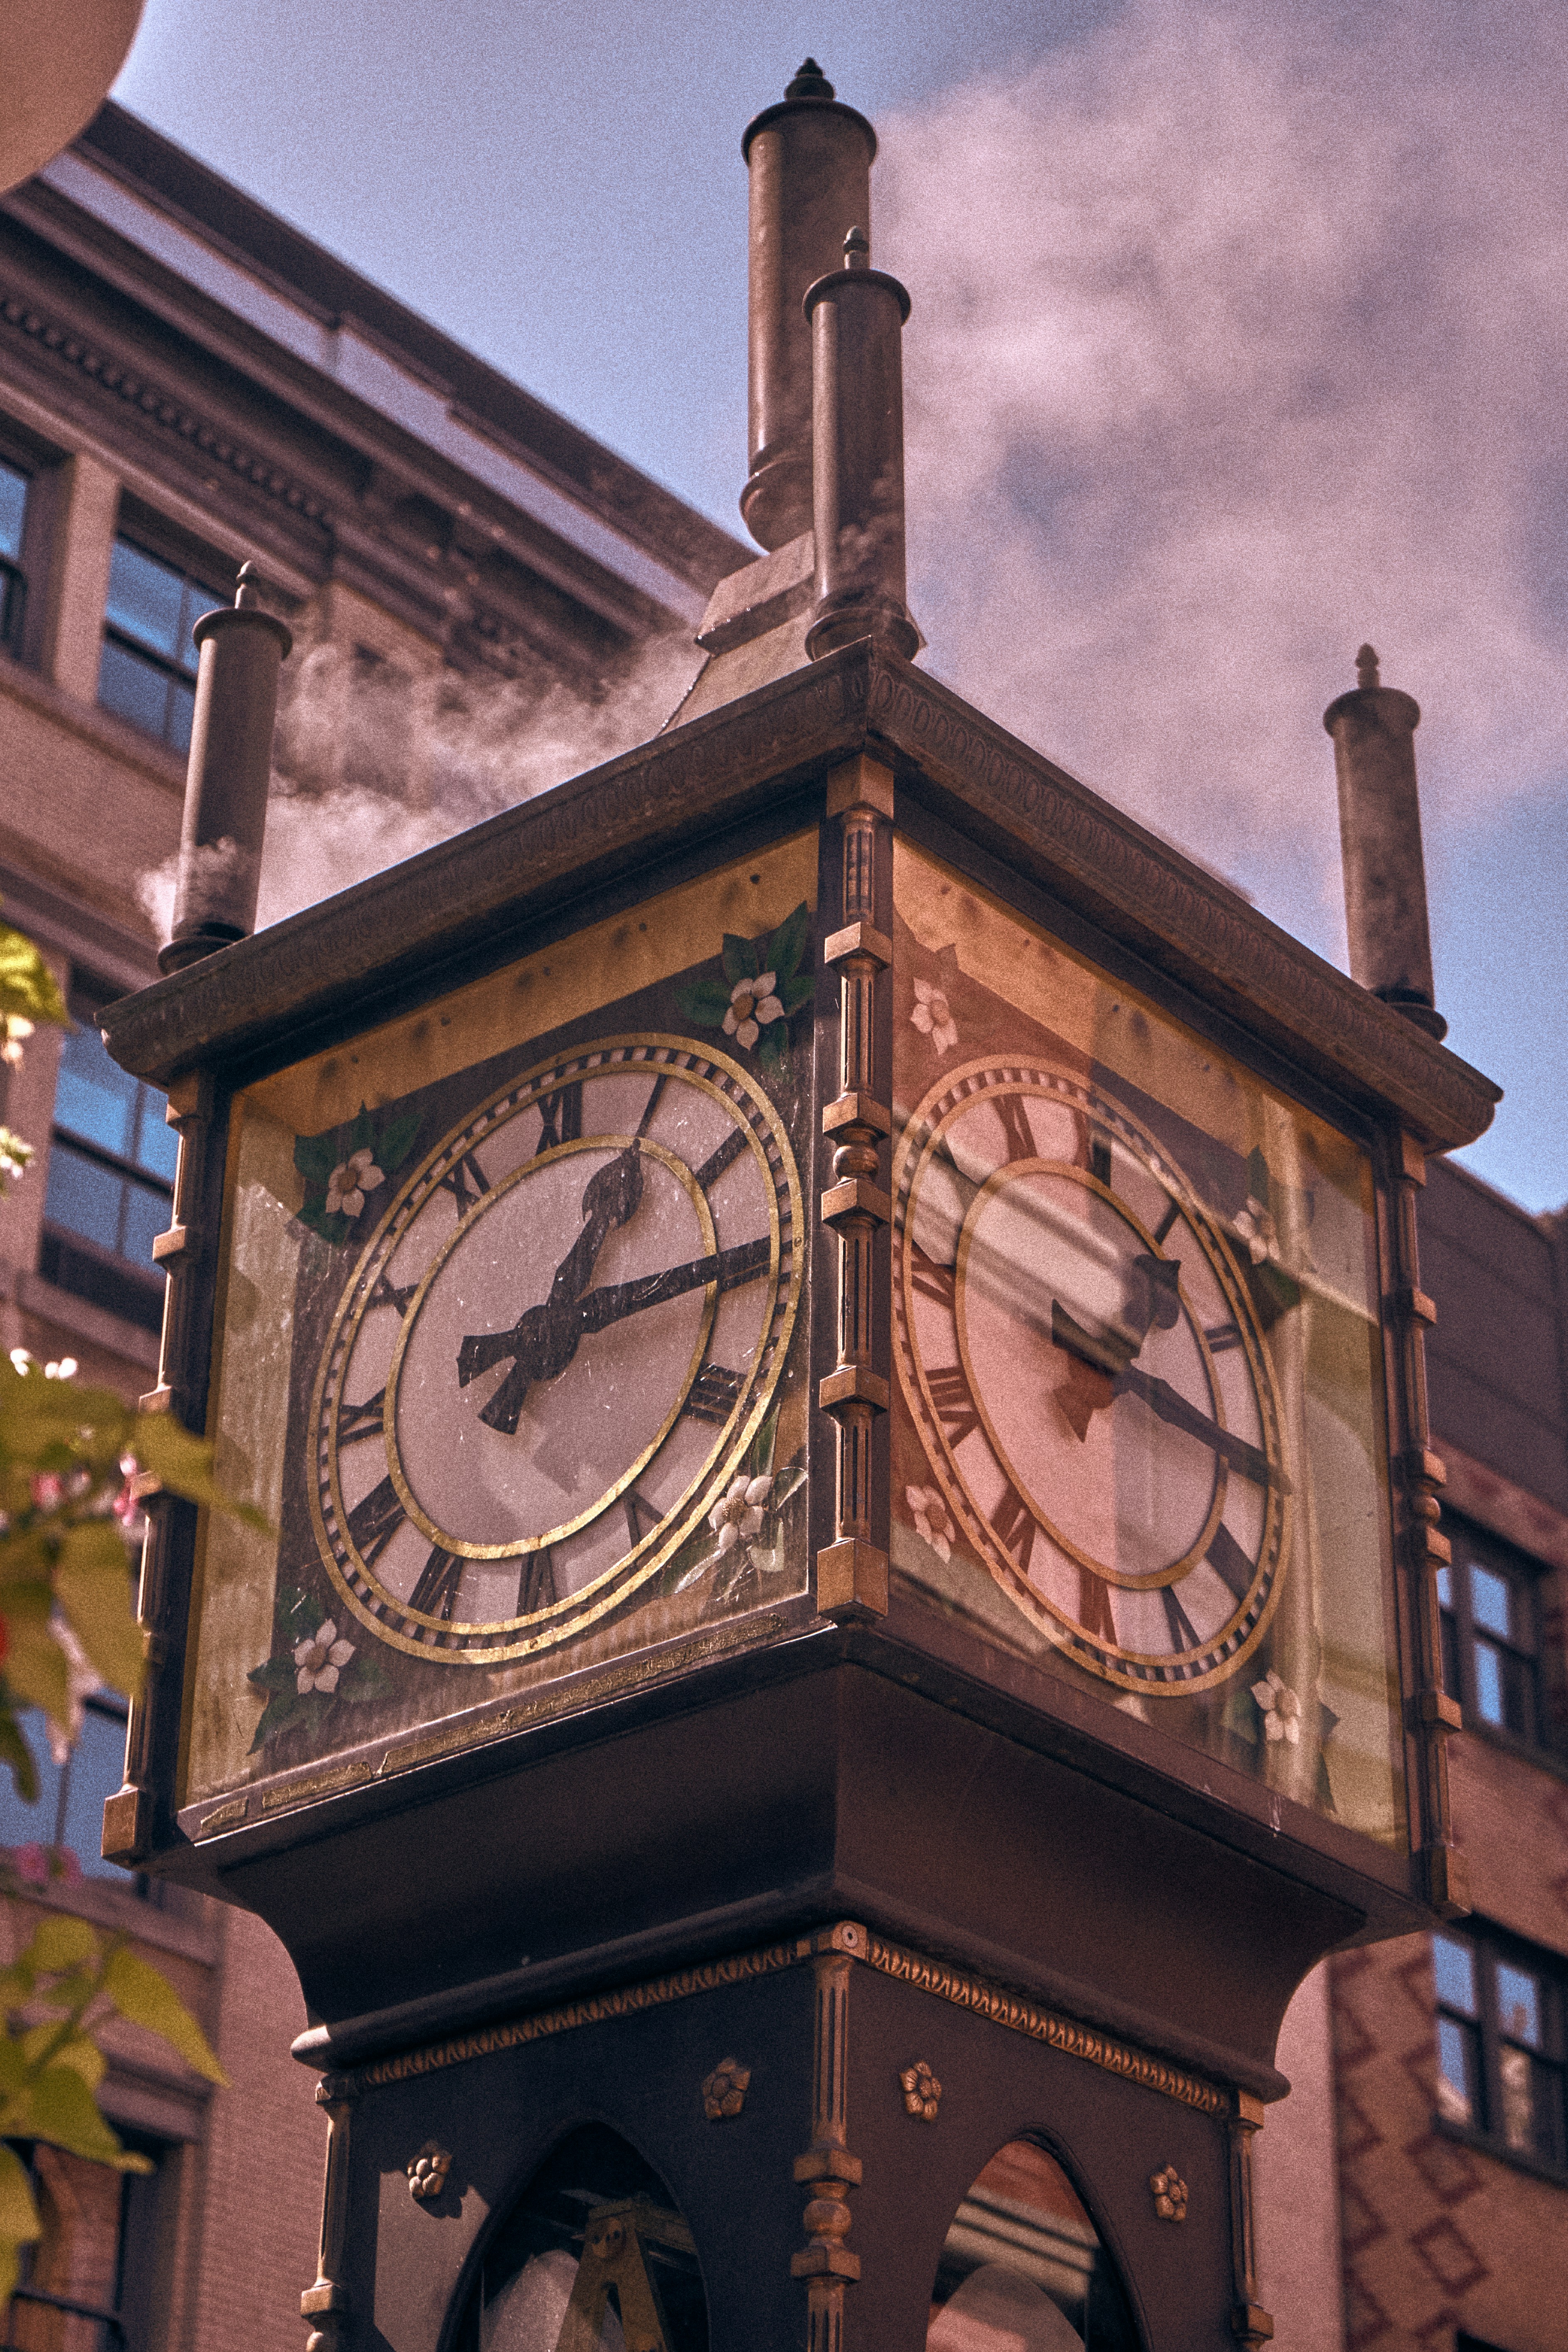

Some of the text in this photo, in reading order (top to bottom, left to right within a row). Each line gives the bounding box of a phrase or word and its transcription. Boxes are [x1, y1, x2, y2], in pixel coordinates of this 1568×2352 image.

[535, 1079, 582, 1158] XII
[437, 1149, 491, 1221] XI
[1153, 1200, 1182, 1246] I
[368, 1271, 420, 1318] X
[912, 1238, 956, 1311] IX
[1204, 1325, 1243, 1354] II
[337, 1387, 384, 1449] IX
[407, 1545, 465, 1621] VII
[516, 1546, 557, 1619] VI
[1161, 1584, 1202, 1654] V
